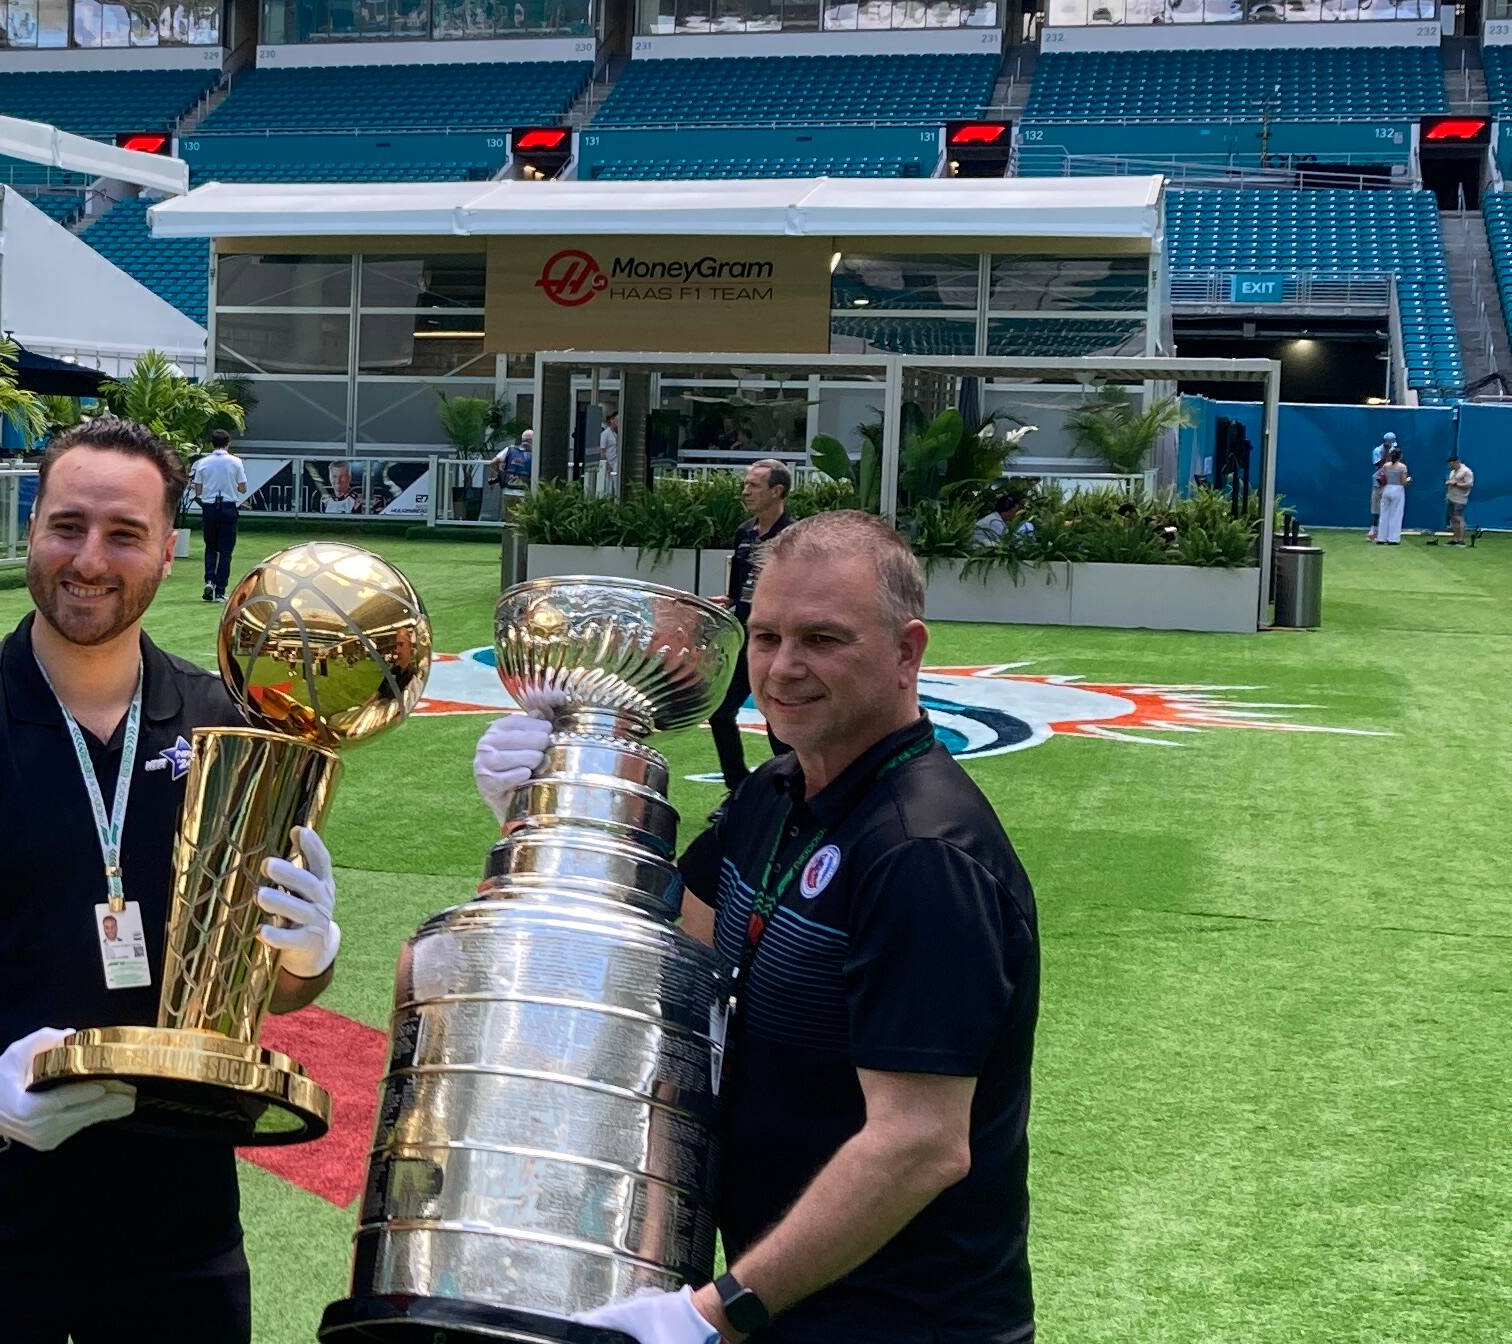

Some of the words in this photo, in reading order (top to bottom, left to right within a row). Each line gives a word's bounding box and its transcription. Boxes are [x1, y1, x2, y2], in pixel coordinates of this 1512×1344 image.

[1416, 27, 1437, 36] 232
[1489, 25, 1510, 35] 233
[981, 34, 998, 43] 231
[1045, 33, 1064, 42] 232
[575, 43, 592, 52] 230
[635, 42, 652, 50] 231
[259, 50, 276, 59] 230
[920, 132, 935, 142] 131
[1025, 131, 1043, 140] 132
[1375, 128, 1394, 138] 132
[184, 141, 200, 151] 130
[487, 138, 504, 147] 130
[585, 137, 600, 146] 131
[611, 256, 775, 283] MoneyGram
[1241, 281, 1276, 294] EXIT
[610, 287, 673, 301] HAAS
[679, 287, 701, 301] F1
[709, 287, 774, 301] TEAM
